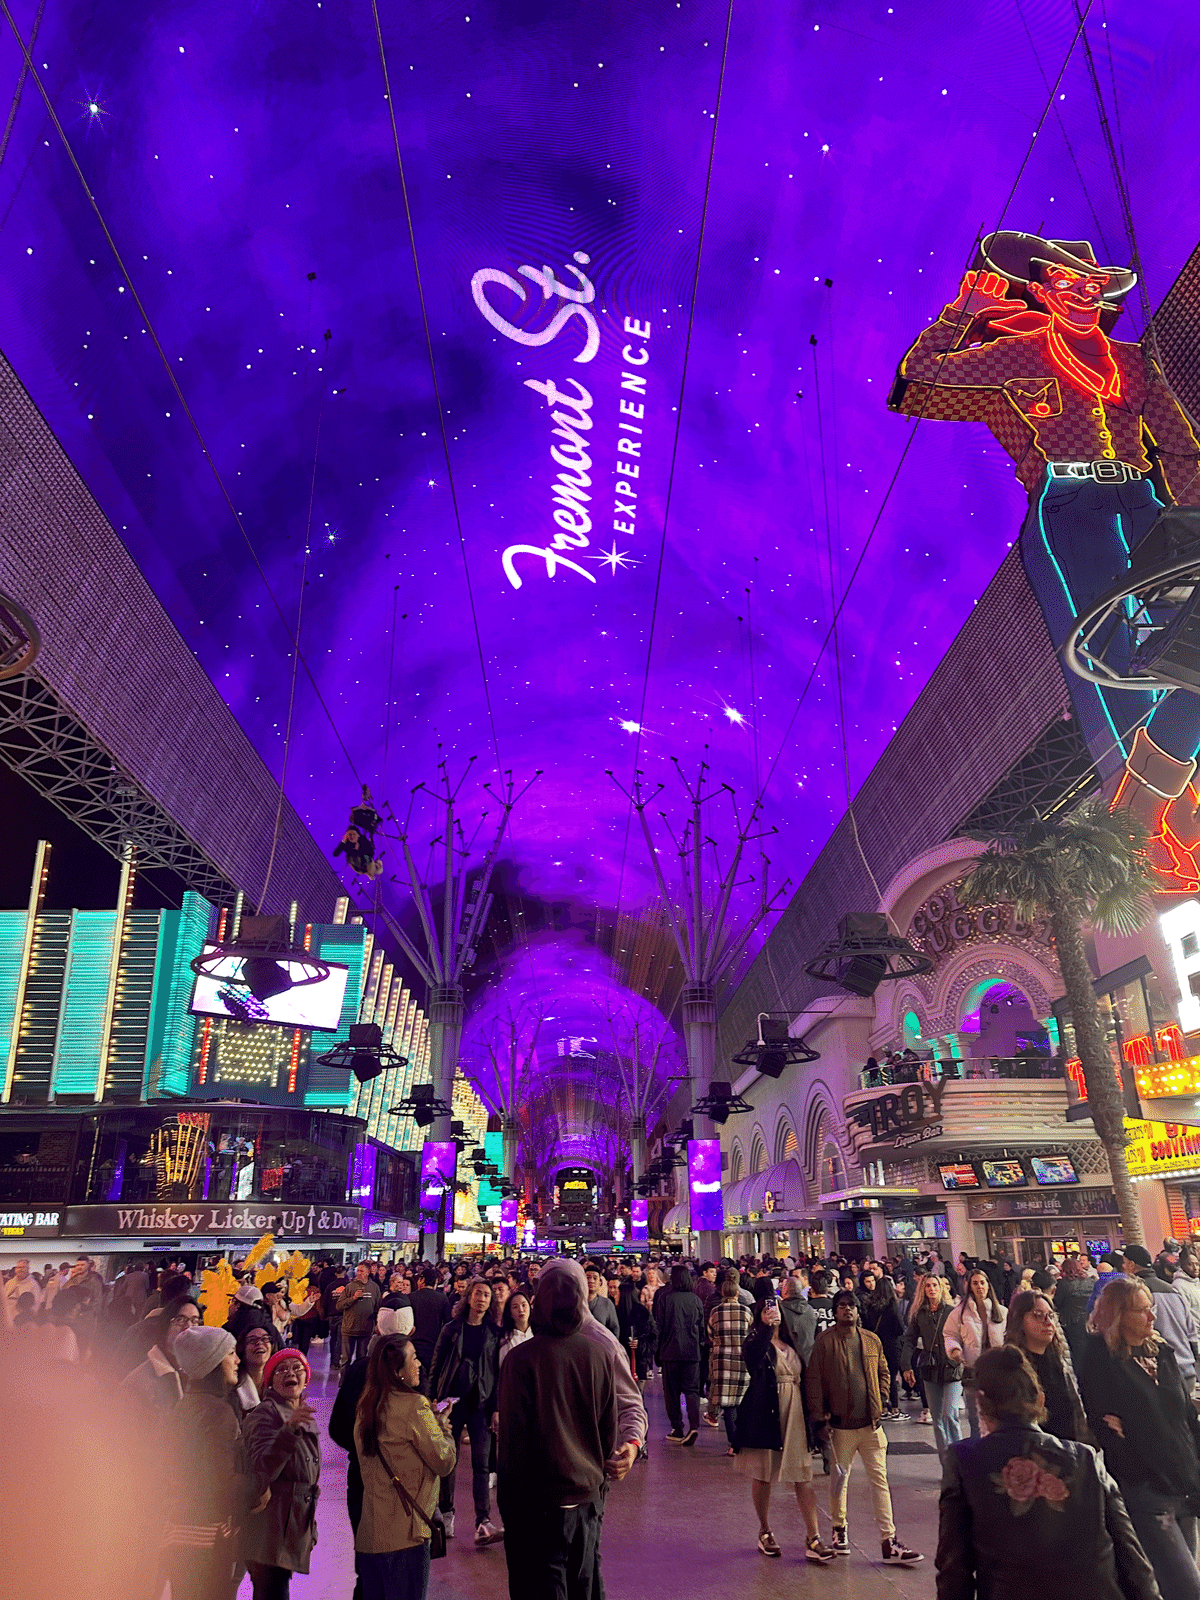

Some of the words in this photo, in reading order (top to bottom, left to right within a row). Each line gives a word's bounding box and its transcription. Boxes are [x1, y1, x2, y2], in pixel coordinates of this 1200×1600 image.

[471, 250, 600, 363] St.
[613, 316, 652, 535] EXPERIENCE
[502, 377, 597, 590] Fremont
[846, 1075, 947, 1137] TROY
[922, 1126, 943, 1140] Bar
[34, 1212, 59, 1226] BAR
[117, 1207, 204, 1234] Whiskey
[207, 1207, 276, 1230] Licker
[281, 1210, 306, 1234] Up
[317, 1210, 330, 1230] &
